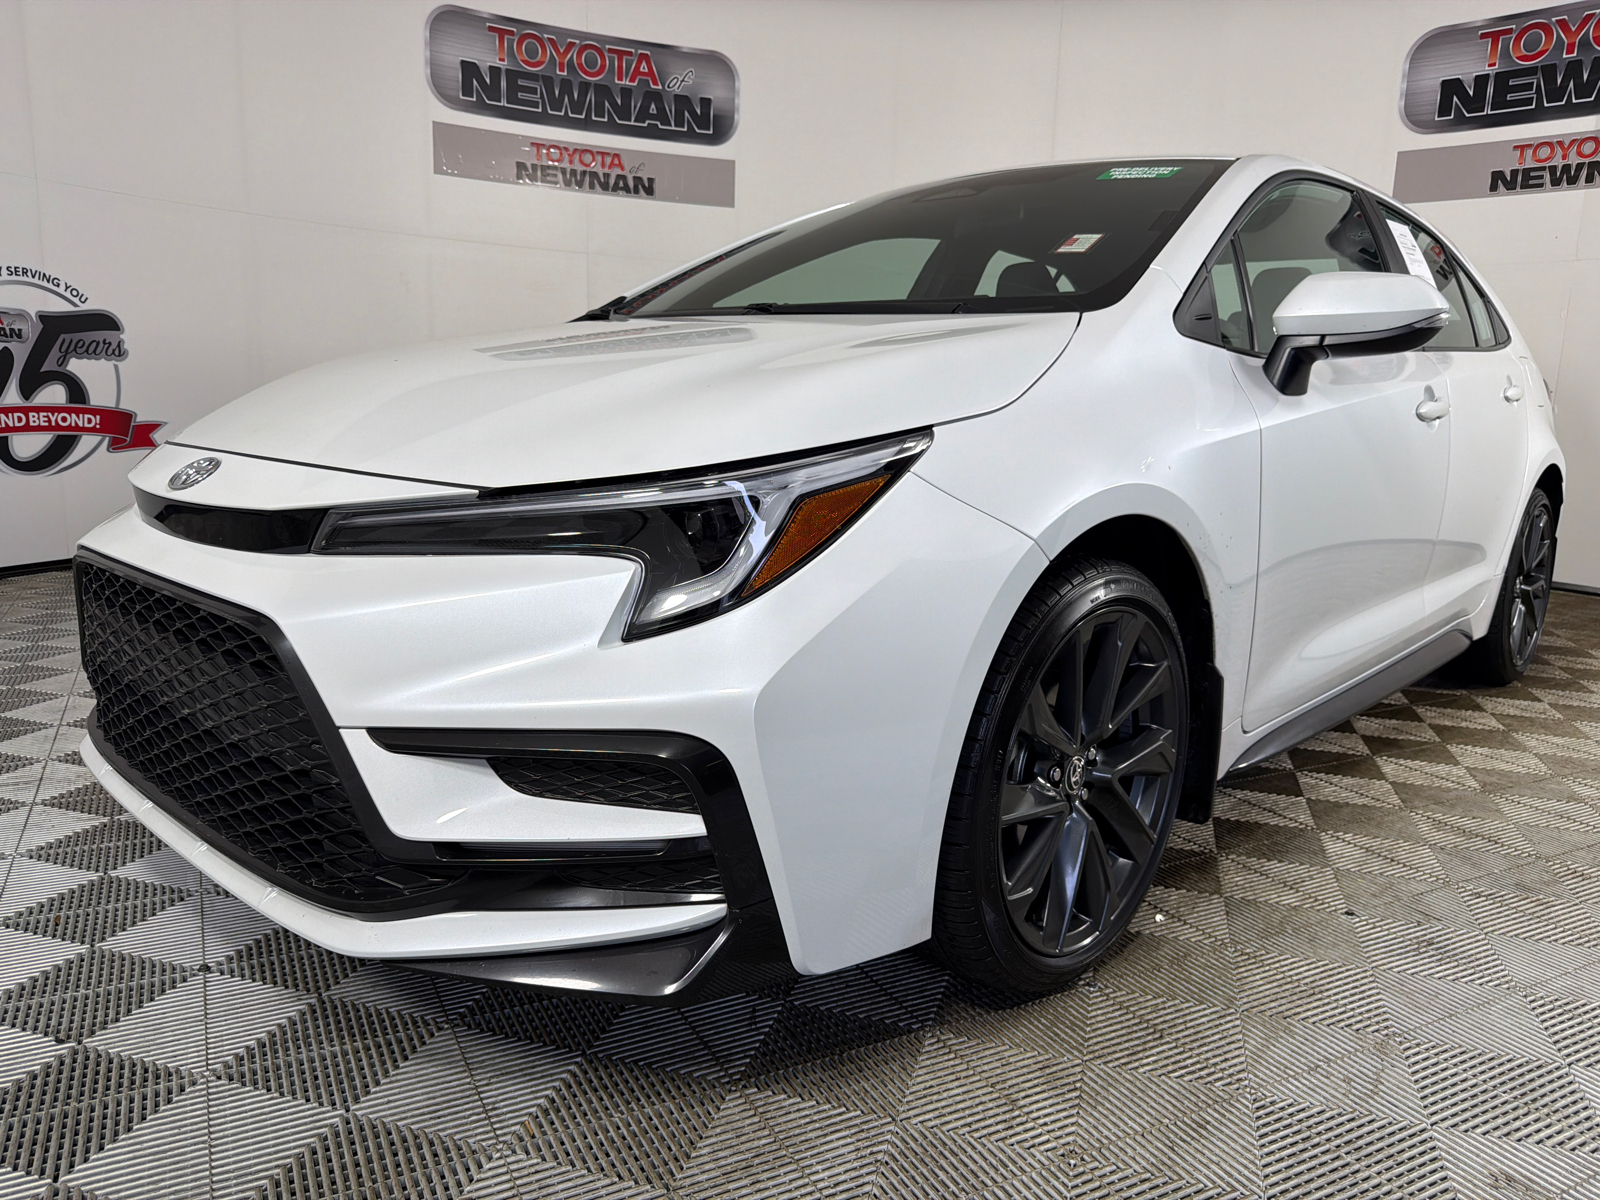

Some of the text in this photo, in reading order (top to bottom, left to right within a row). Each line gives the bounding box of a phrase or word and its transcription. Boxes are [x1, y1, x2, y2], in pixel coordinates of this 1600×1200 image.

[487, 23, 695, 92] TOYOTA of
[1478, 10, 1600, 70] TOY
[458, 58, 714, 134] NEWNAN
[530, 141, 646, 174] TOYOTA of
[515, 161, 656, 198] NEWNAN
[6, 266, 61, 288] SERVING
[64, 281, 89, 304] YOU
[56, 337, 125, 368] years
[28, 412, 101, 429] BEYOND!
